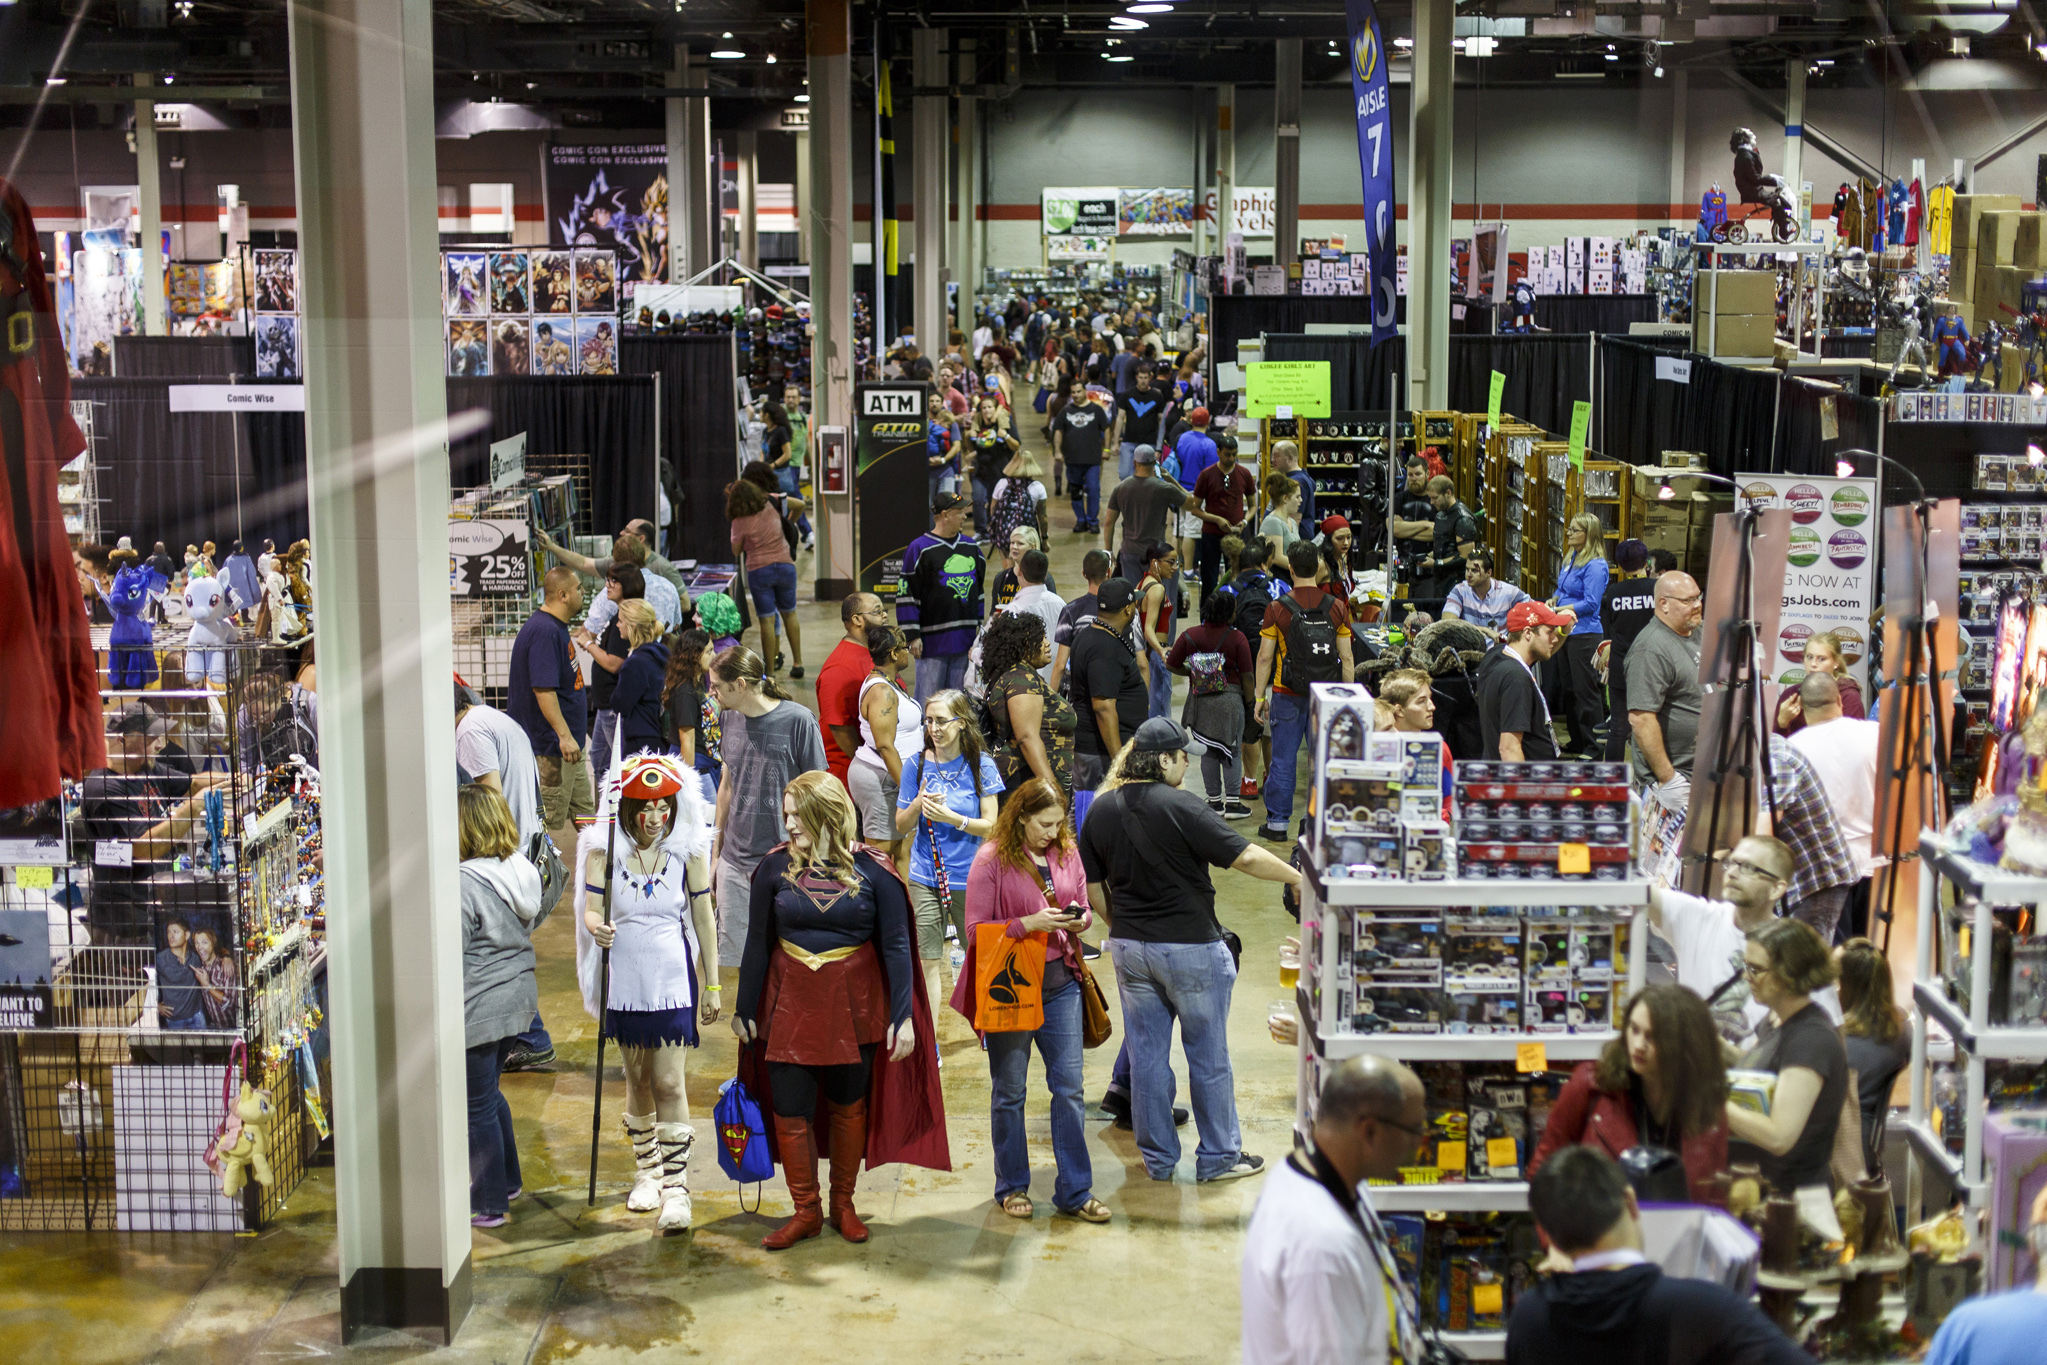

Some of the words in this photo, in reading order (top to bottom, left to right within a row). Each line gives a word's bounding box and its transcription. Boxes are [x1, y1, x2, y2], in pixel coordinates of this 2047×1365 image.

[1358, 86, 1386, 119] AISLE
[552, 147, 585, 155] COMIC
[587, 146, 609, 154] CON
[611, 144, 667, 153] EXCLUSIVE
[553, 156, 586, 164] COMIC
[589, 156, 612, 164] CON
[614, 156, 669, 164] EXCLUSIVE
[1083, 202, 1107, 214] each
[227, 394, 252, 403] Comic
[255, 394, 275, 403] Wise
[870, 395, 913, 413] ATM
[872, 422, 921, 433] ATM
[1794, 488, 1816, 496] HELLO
[1840, 490, 1862, 498] HELLO
[1790, 499, 1820, 510] SWEET!
[448, 535, 470, 544] omic
[472, 535, 494, 543] Wise
[480, 555, 525, 579] 25%
[511, 570, 526, 578] OFF
[1798, 574, 1839, 589] NOW
[1842, 577, 1862, 590] AT
[1611, 595, 1656, 611] CREW
[1781, 594, 1861, 609] gsJobs.com
[27, 997, 43, 1012] TO
